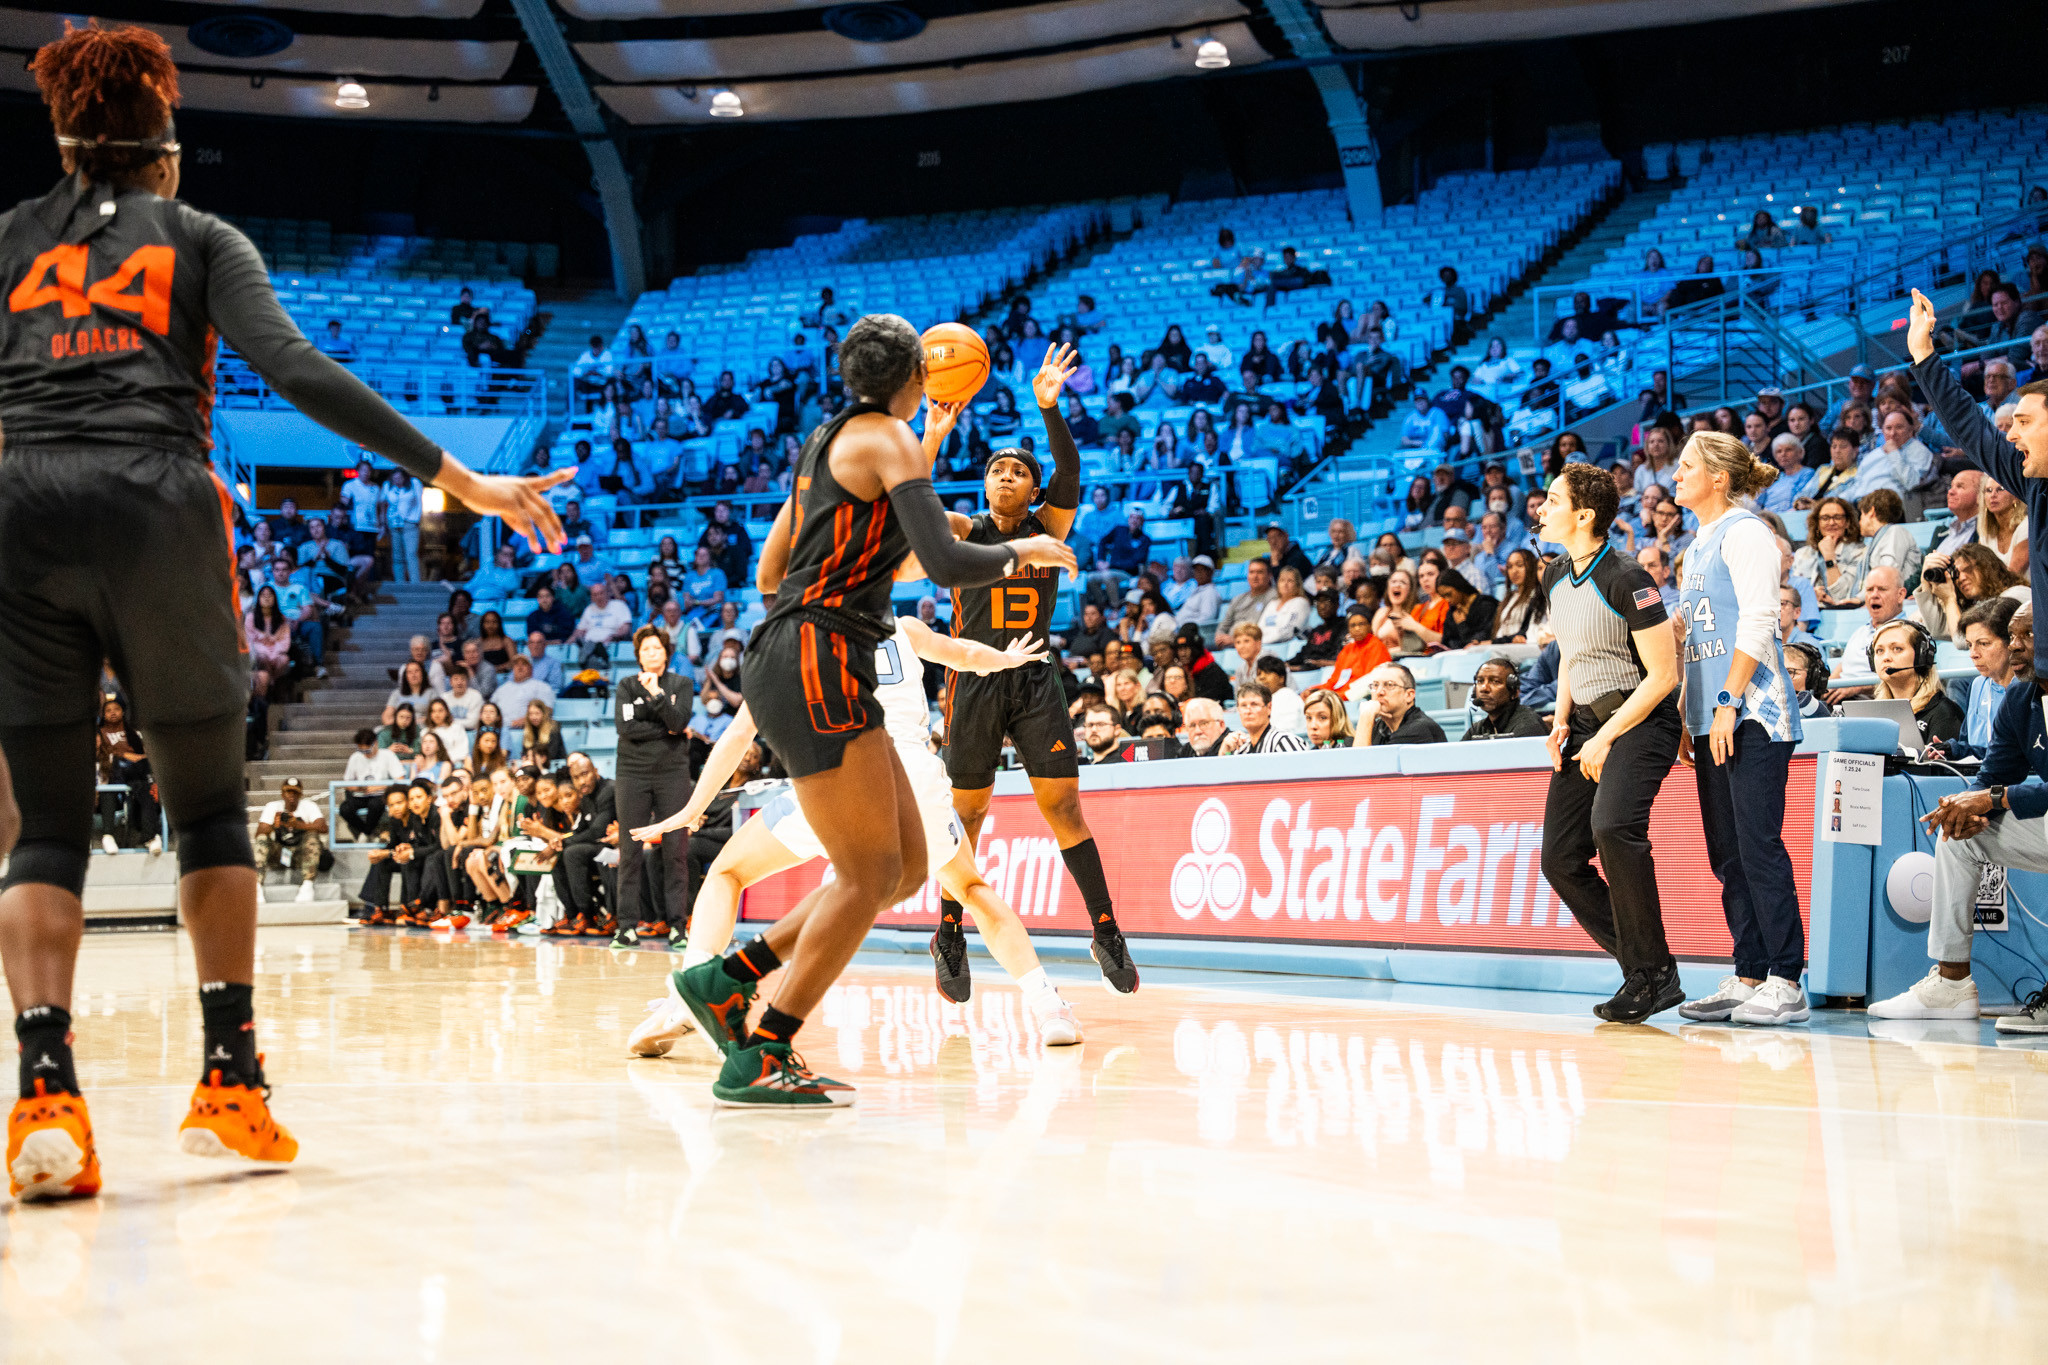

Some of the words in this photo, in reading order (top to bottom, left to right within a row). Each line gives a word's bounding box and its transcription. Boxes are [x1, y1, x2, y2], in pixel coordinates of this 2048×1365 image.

[9, 243, 176, 336] 44
[990, 586, 1040, 629] 13
[1848, 759, 1876, 767] OFFICIALS
[1986, 912, 1997, 921] ME
